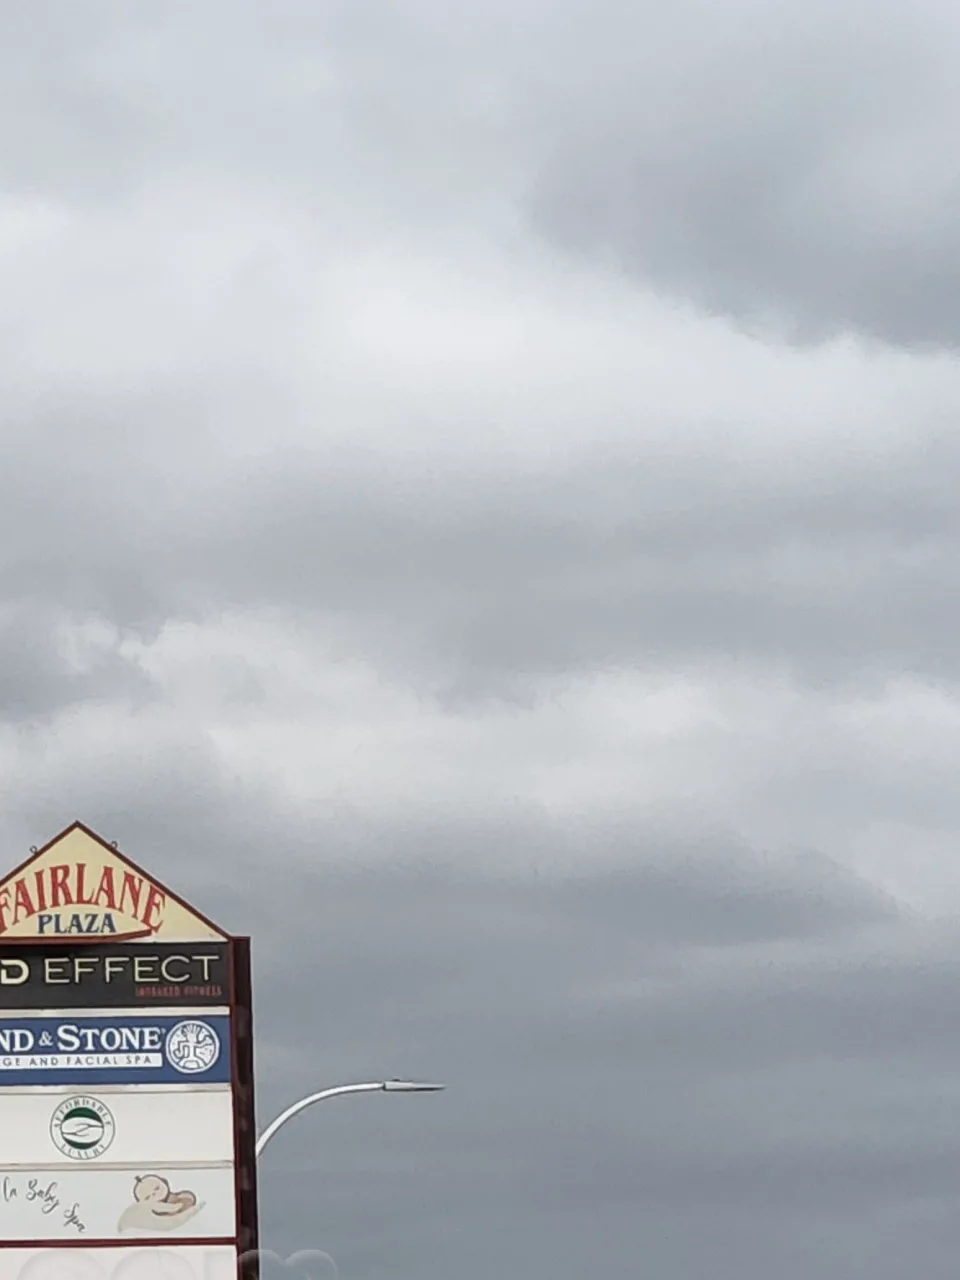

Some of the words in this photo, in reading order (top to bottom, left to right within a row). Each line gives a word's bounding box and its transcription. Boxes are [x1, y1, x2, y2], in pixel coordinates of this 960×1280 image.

[37, 913, 117, 934] PLAZA
[44, 955, 220, 984] EFFECT
[39, 1031, 54, 1047] &
[29, 1056, 59, 1067] AND
[66, 1055, 118, 1066] FACIAL
[125, 1054, 152, 1065] SPA
[63, 1202, 86, 1233] Spa
